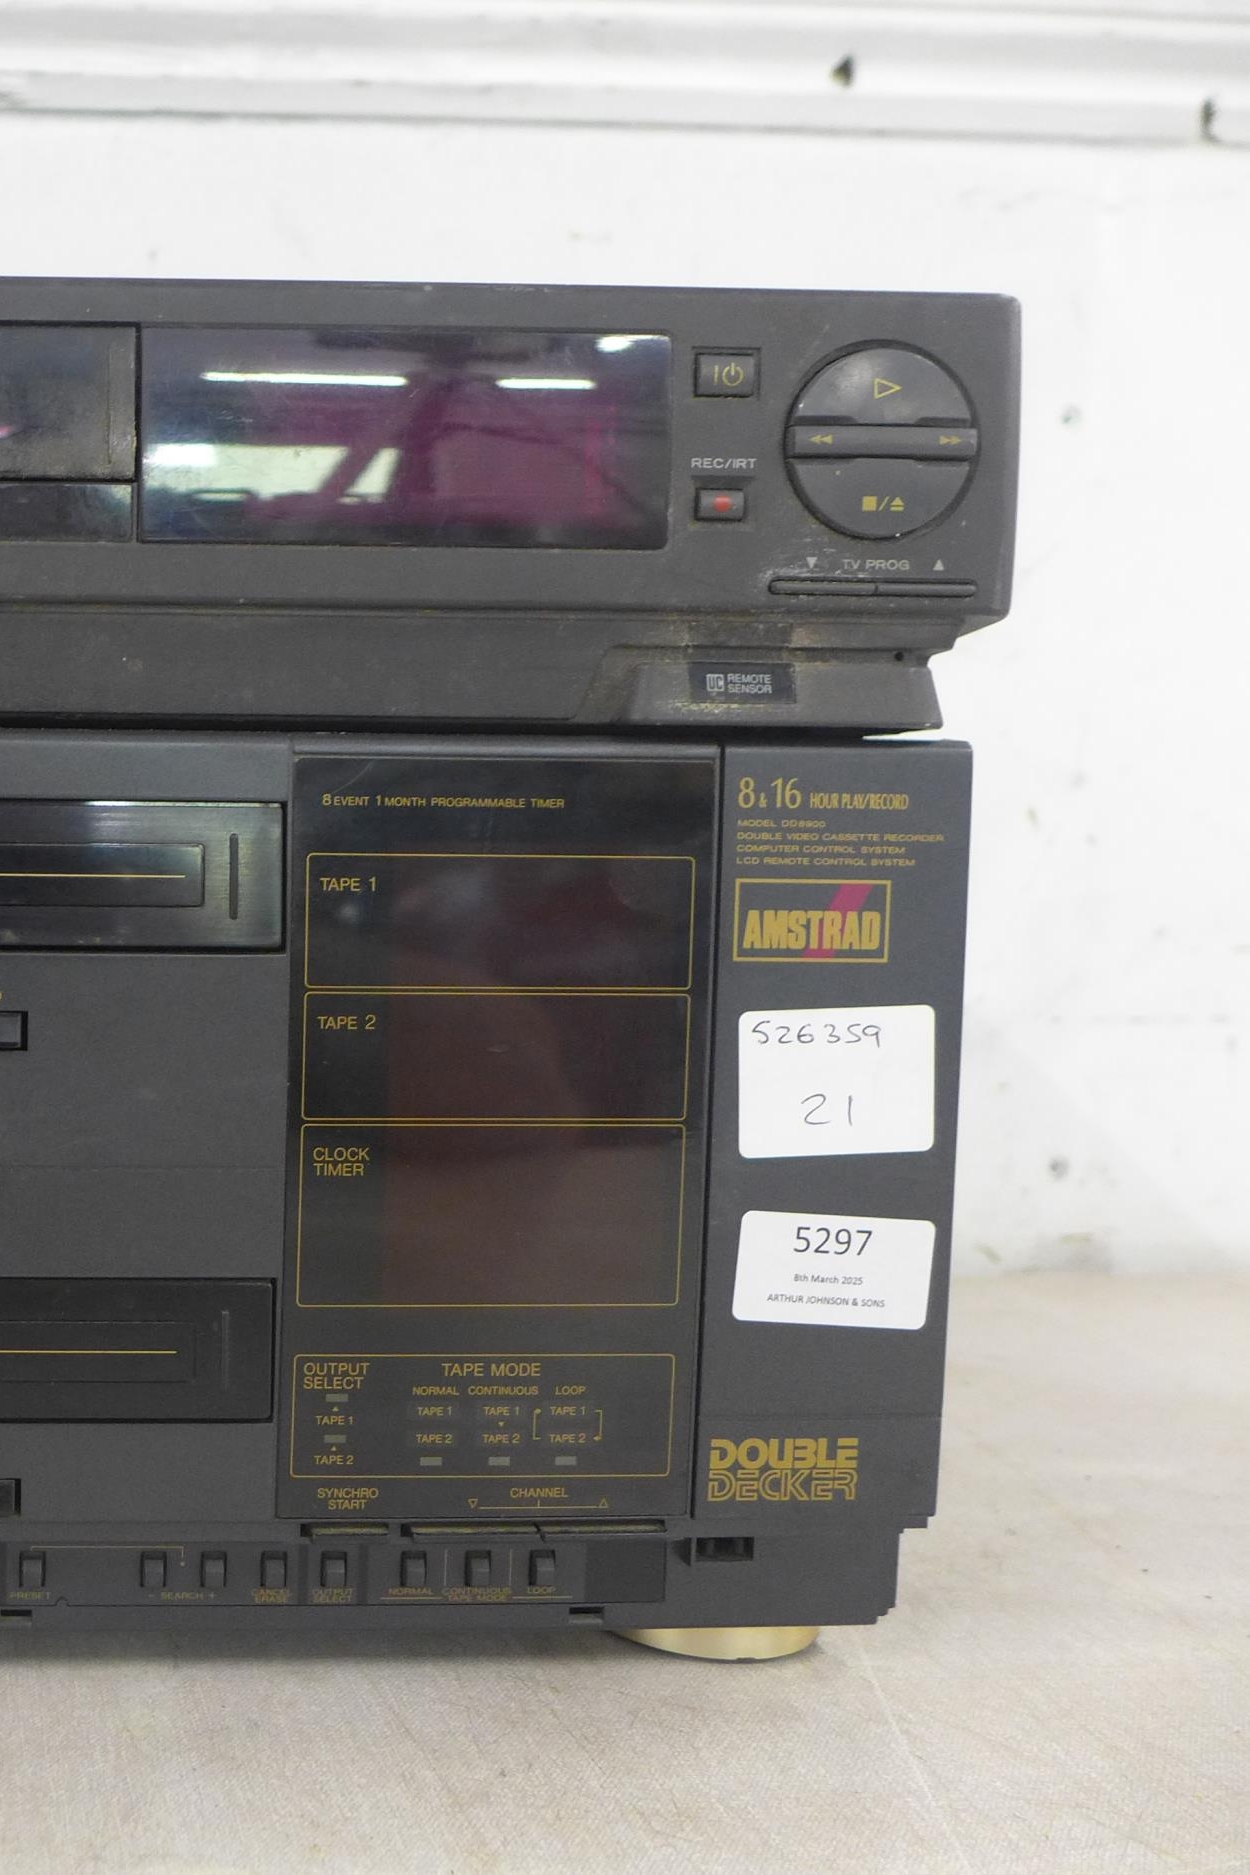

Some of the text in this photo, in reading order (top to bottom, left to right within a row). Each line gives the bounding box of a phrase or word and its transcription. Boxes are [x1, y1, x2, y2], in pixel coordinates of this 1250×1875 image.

[691, 457, 758, 469] REC/IRT
[843, 560, 911, 572] TV PROG
[726, 673, 772, 684] REMOTE
[727, 683, 773, 694] SENSOR
[737, 776, 756, 809] 8
[770, 776, 803, 809] 16
[809, 792, 840, 809] HOUR
[842, 792, 910, 810] PLAY/RECORD
[322, 793, 565, 809] 8 EVENT 1 MONTH PROGRAMMABLE TIMER
[737, 818, 777, 828] MODEL
[736, 831, 945, 843] DOUBLE VIDEO CASSETTE RECORDER
[736, 843, 907, 854] COMPUTER CONTROL SYSTEM
[736, 856, 916, 867] LCD REMOTE CONTROL SYSTEM
[319, 877, 377, 892] TAPE 1
[742, 909, 882, 951] AMSTRAD
[317, 1014, 377, 1030] TAPE 2
[751, 1019, 882, 1048] 526359
[801, 1092, 854, 1126] 21
[312, 1146, 370, 1161] CLOCK
[313, 1163, 365, 1177] TIMER
[792, 1226, 873, 1257] 5297
[793, 1273, 863, 1286] 8th March 2025
[766, 1293, 886, 1308] ARTHUR JOHNSON & SONS
[303, 1362, 370, 1376] OUTPUT
[441, 1362, 542, 1377] TAPE MODE
[303, 1376, 365, 1390] SELECT
[412, 1385, 459, 1396] NORMAL
[467, 1385, 539, 1396] CONTINUOUS
[555, 1385, 587, 1396] LOOP
[417, 1406, 453, 1416] TAPE 1
[483, 1406, 520, 1416] TAPE 1
[549, 1405, 587, 1416] TAPE 1
[315, 1415, 355, 1426] TAPE 1
[415, 1433, 453, 1444] TAPE 2
[482, 1433, 520, 1444] TAPE 2
[549, 1432, 587, 1444] TAPE 2
[708, 1437, 860, 1470] DOUBLE
[313, 1455, 354, 1465] TAPE 2
[707, 1469, 858, 1502] DECKER
[317, 1487, 379, 1499] SYNCHRO
[509, 1487, 569, 1499] CHANNEL
[327, 1499, 367, 1510] START
[160, 1591, 204, 1600] SEARCH
[312, 1588, 354, 1596] OUTPUT
[388, 1587, 434, 1596] NORMAL
[442, 1587, 512, 1596] CONTINUOUS
[527, 1586, 556, 1595] LOOP
[314, 1595, 352, 1604] SELECT
